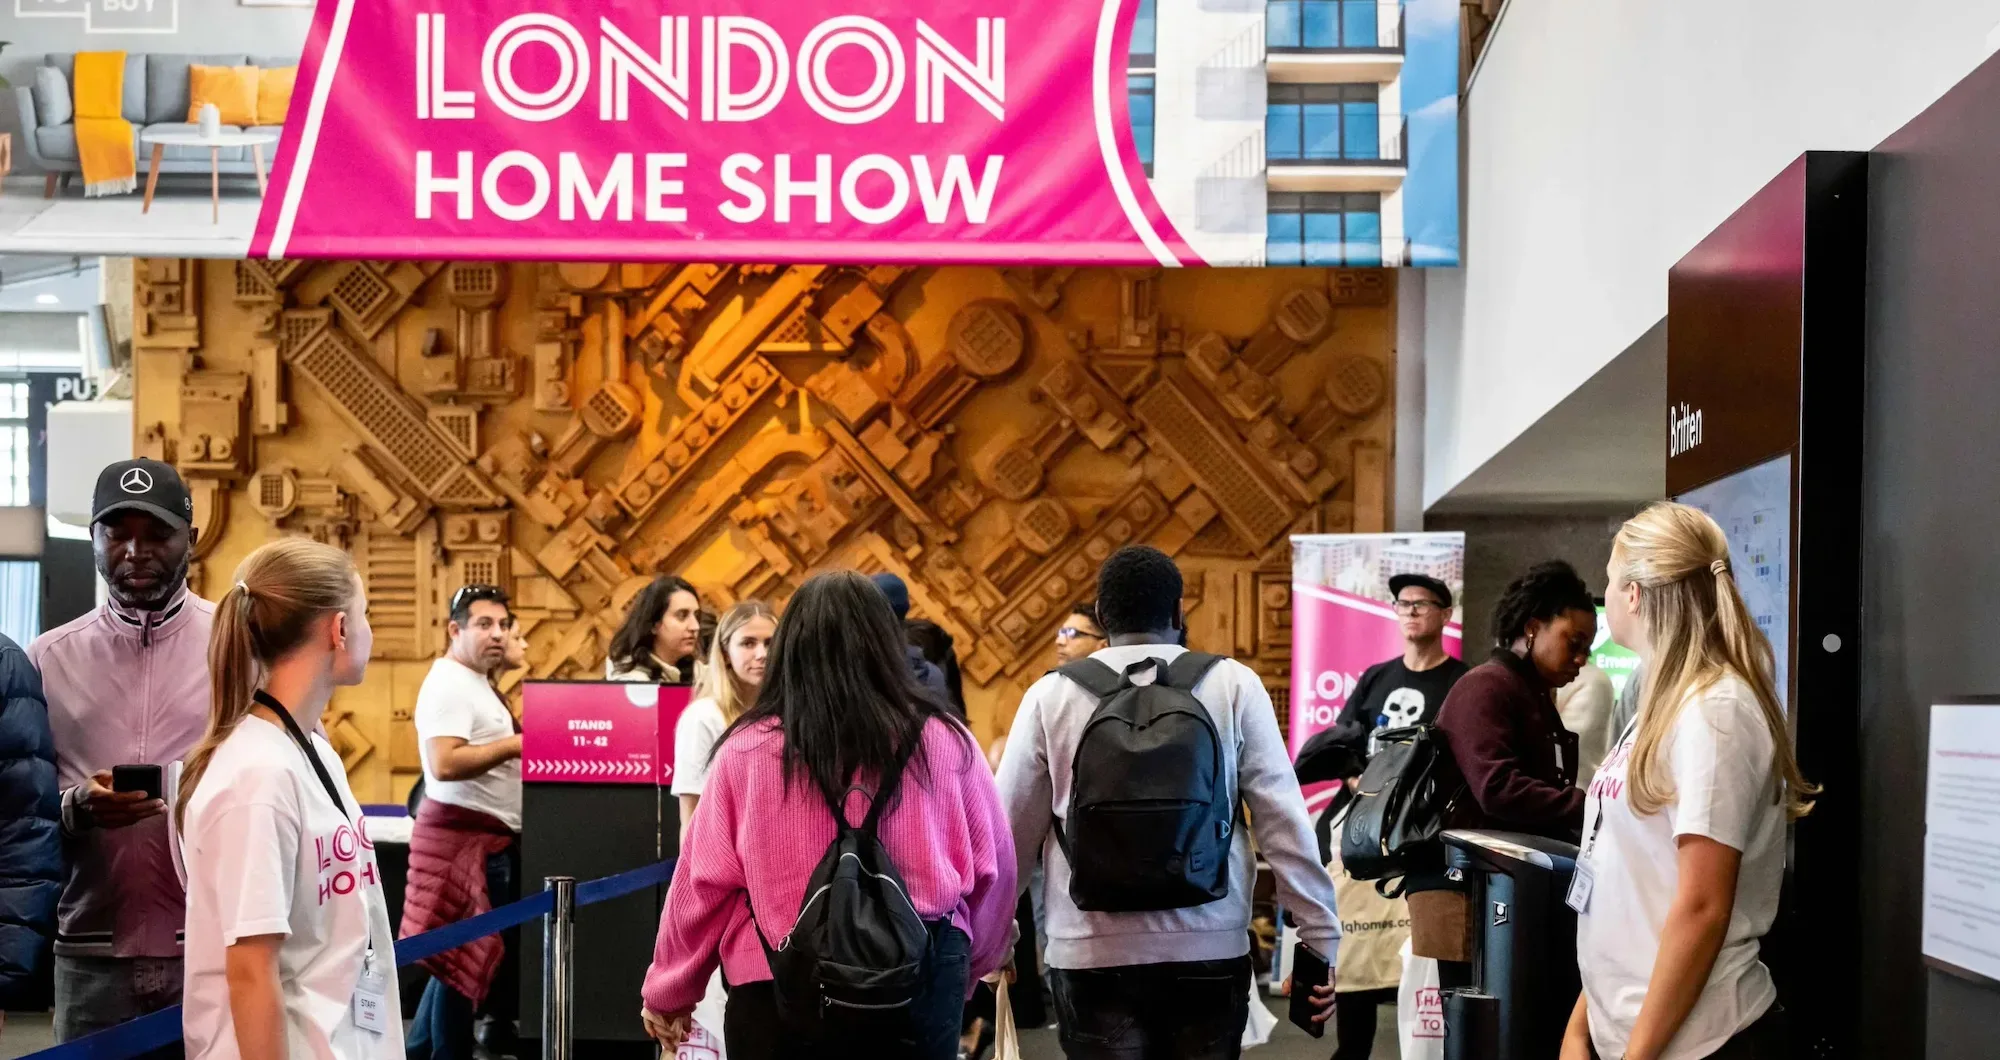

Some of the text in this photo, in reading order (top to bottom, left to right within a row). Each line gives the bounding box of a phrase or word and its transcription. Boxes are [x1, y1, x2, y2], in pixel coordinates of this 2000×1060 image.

[416, 12, 1006, 124] LONDON
[415, 150, 1005, 224] HOME SHOW
[1670, 400, 1702, 458] Britten
[1303, 670, 1363, 701] LON
[568, 720, 613, 731] STANDS
[593, 736, 608, 747] 42
[1421, 1019, 1440, 1030] TO
